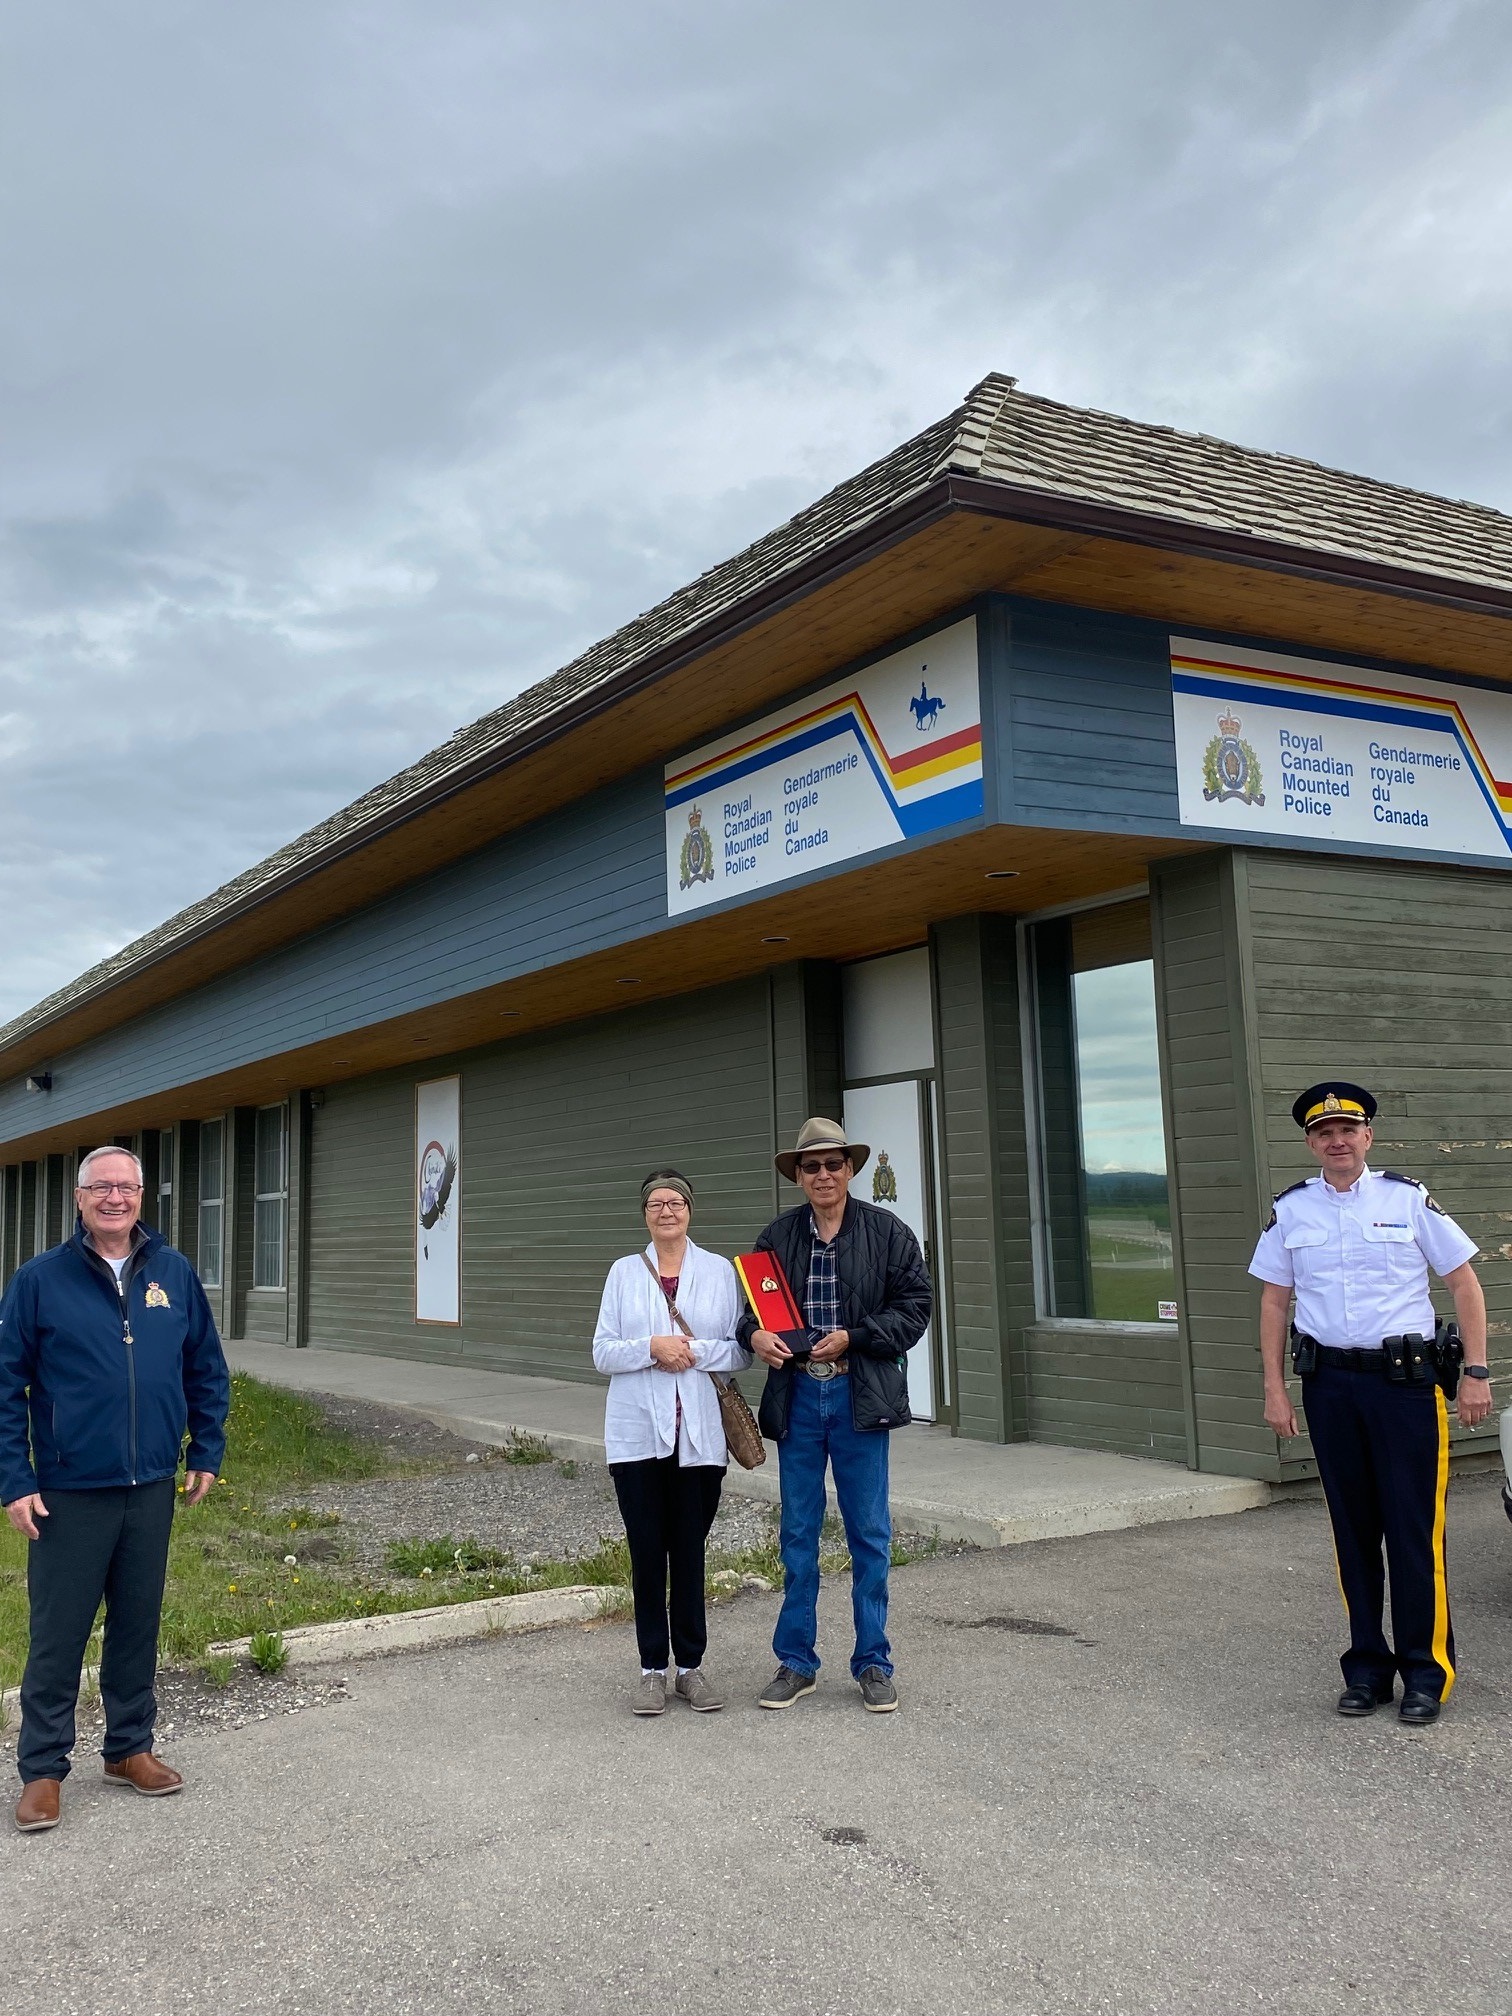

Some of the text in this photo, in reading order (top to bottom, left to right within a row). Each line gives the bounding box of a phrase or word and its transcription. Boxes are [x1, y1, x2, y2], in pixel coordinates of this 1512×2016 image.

[1279, 729, 1323, 754] Royal
[1281, 751, 1354, 777] Canadian
[1369, 742, 1461, 771] Gendarmerie
[784, 753, 858, 795] Gendarmerie
[1282, 772, 1350, 797] Mounted
[1370, 766, 1415, 786] royale
[784, 790, 819, 816] royale
[1284, 794, 1332, 816] Police
[1372, 785, 1391, 802] du
[723, 794, 752, 820] Royal
[1373, 805, 1429, 827] Canada
[724, 809, 772, 838] Canadian
[784, 819, 799, 836] du
[724, 827, 769, 858] Mounted
[785, 828, 829, 856] Canada
[725, 855, 756, 877] Police
